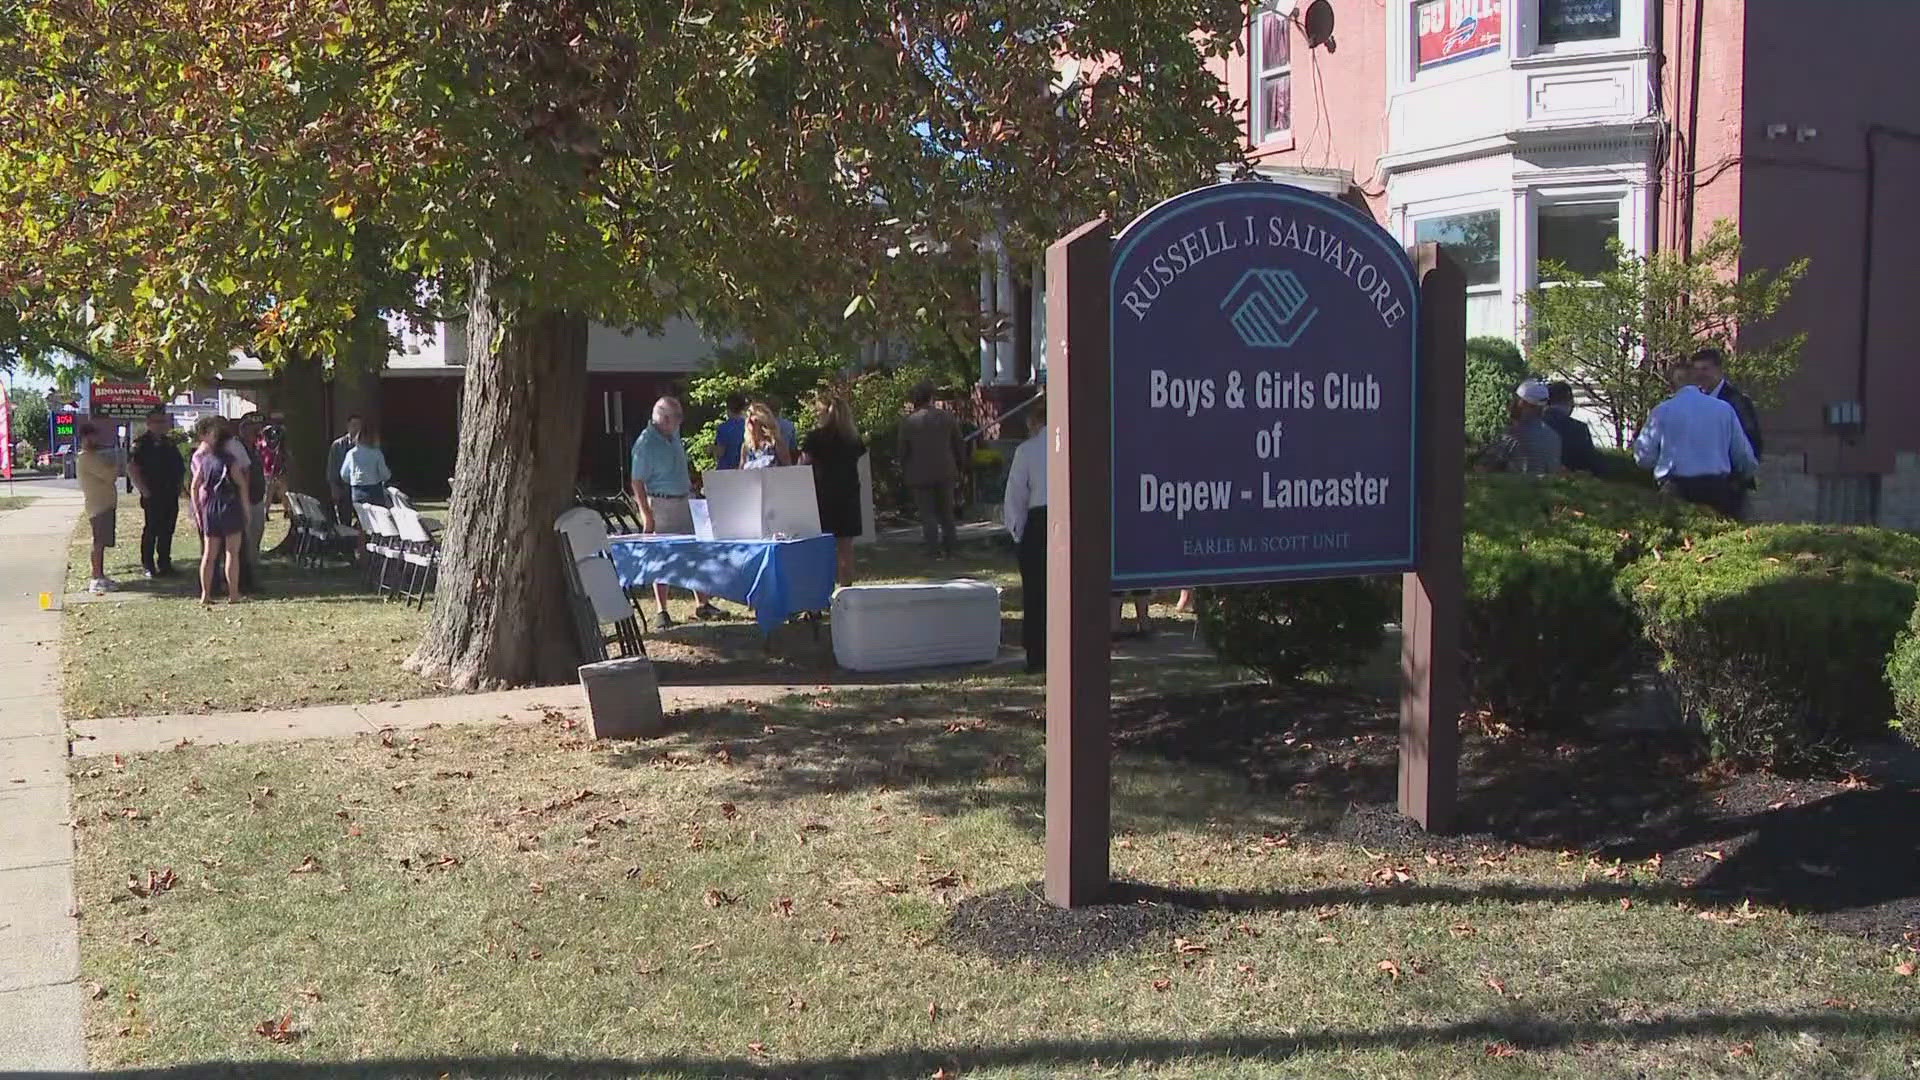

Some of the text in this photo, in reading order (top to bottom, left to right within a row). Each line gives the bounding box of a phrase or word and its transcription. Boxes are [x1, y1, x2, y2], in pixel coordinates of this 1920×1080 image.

[1419, 3, 1445, 36] GO
[1121, 216, 1406, 329] RUSSELL J. SALVATORE
[95, 388, 140, 397] BROADWAY
[1150, 369, 1381, 417] Boys & Girls Club
[1256, 421, 1283, 459] of
[1140, 473, 1232, 520] Depew
[1262, 471, 1390, 509] Lancaster
[1183, 531, 1351, 556] EARLE M. SCOTT UNIT
